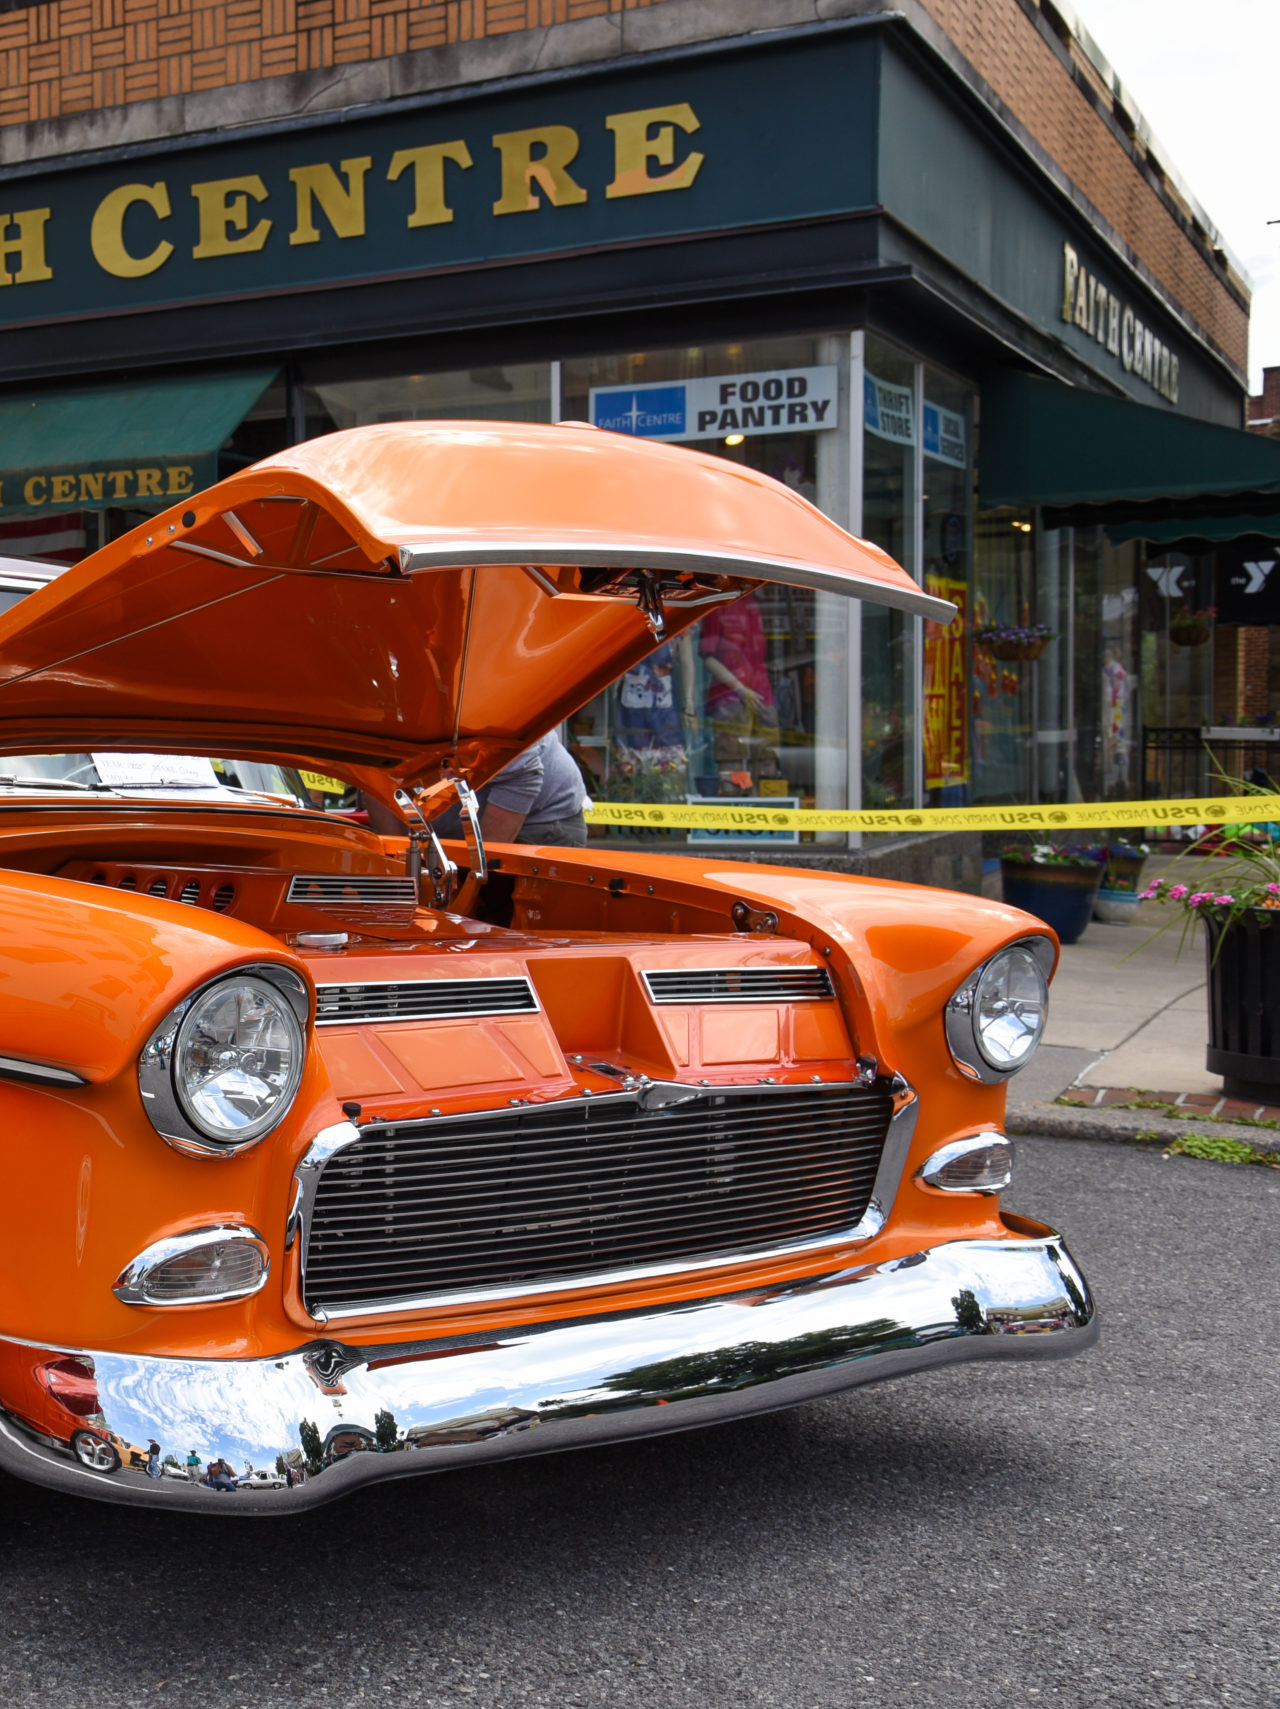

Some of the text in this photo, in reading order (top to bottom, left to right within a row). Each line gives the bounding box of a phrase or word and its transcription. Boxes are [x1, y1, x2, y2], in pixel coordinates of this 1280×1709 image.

[90, 102, 705, 279] CENTRE
[1061, 240, 1180, 404] FAITH CENTRE
[719, 376, 808, 405] FOOD
[598, 411, 683, 429] FAITH CENTRE
[697, 400, 832, 432] PANTRY
[880, 410, 912, 439] STORE
[23, 466, 196, 506] CENTRE
